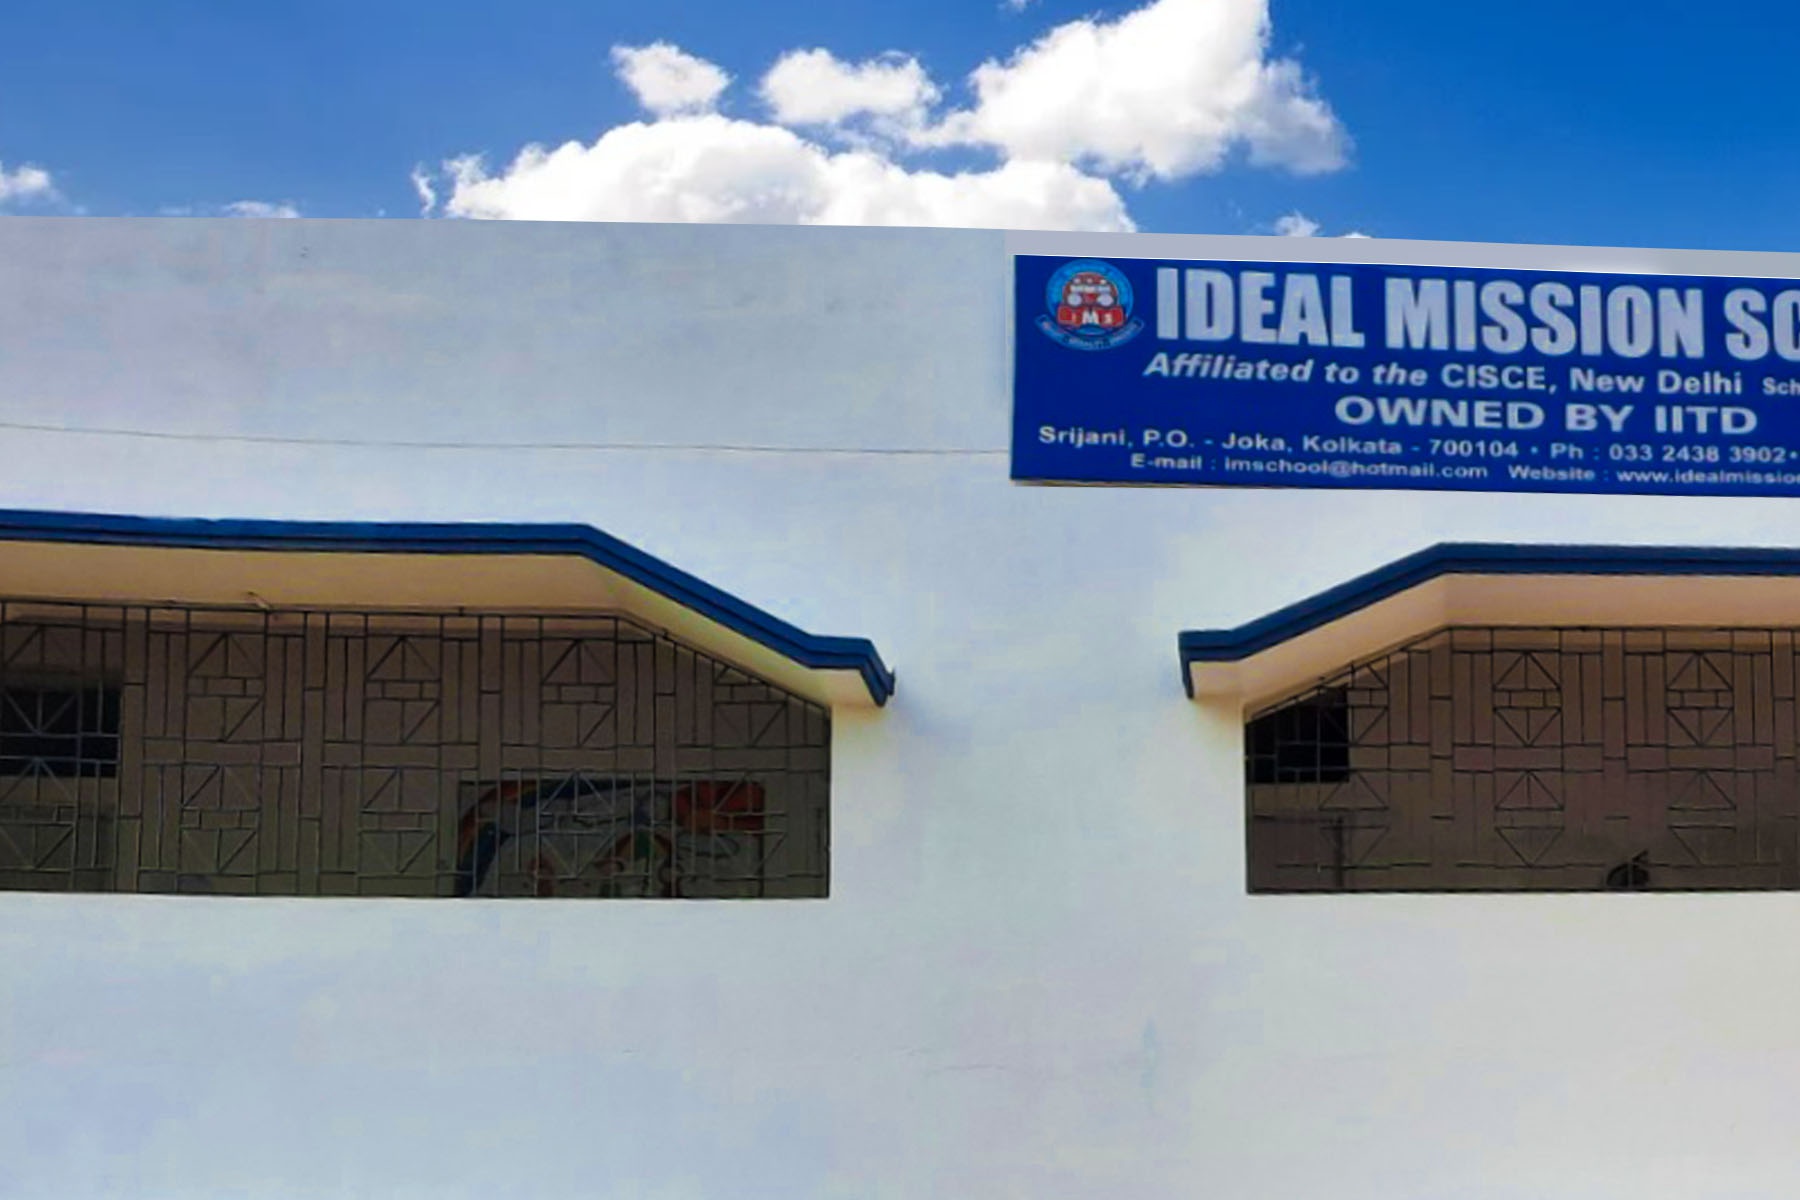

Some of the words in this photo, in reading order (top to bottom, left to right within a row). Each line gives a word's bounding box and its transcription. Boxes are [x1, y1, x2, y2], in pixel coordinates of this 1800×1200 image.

[1157, 267, 1365, 348] IDEAL
[1385, 277, 1704, 358] MISSION
[1143, 352, 1314, 382] Affiliated
[1325, 362, 1359, 384] to
[1373, 362, 1428, 386] the
[1441, 363, 1557, 394] CISCE,
[1570, 368, 1645, 392] New
[1658, 370, 1742, 395] Delhi
[1335, 396, 1545, 430] OWNED
[1566, 403, 1634, 432] BY
[1655, 406, 1757, 434] IITD
[1039, 426, 1133, 448] Srijani,
[1222, 433, 1292, 452] Joka,
[1303, 435, 1402, 455] Kolkata
[1430, 439, 1518, 457] 700104
[1550, 443, 1584, 459] Ph
[1609, 443, 1653, 461] 033
[1662, 445, 1719, 462] 2438
[1730, 446, 1786, 463] 3902
[1131, 453, 1202, 469] E-mail
[1508, 465, 1595, 481] Website
